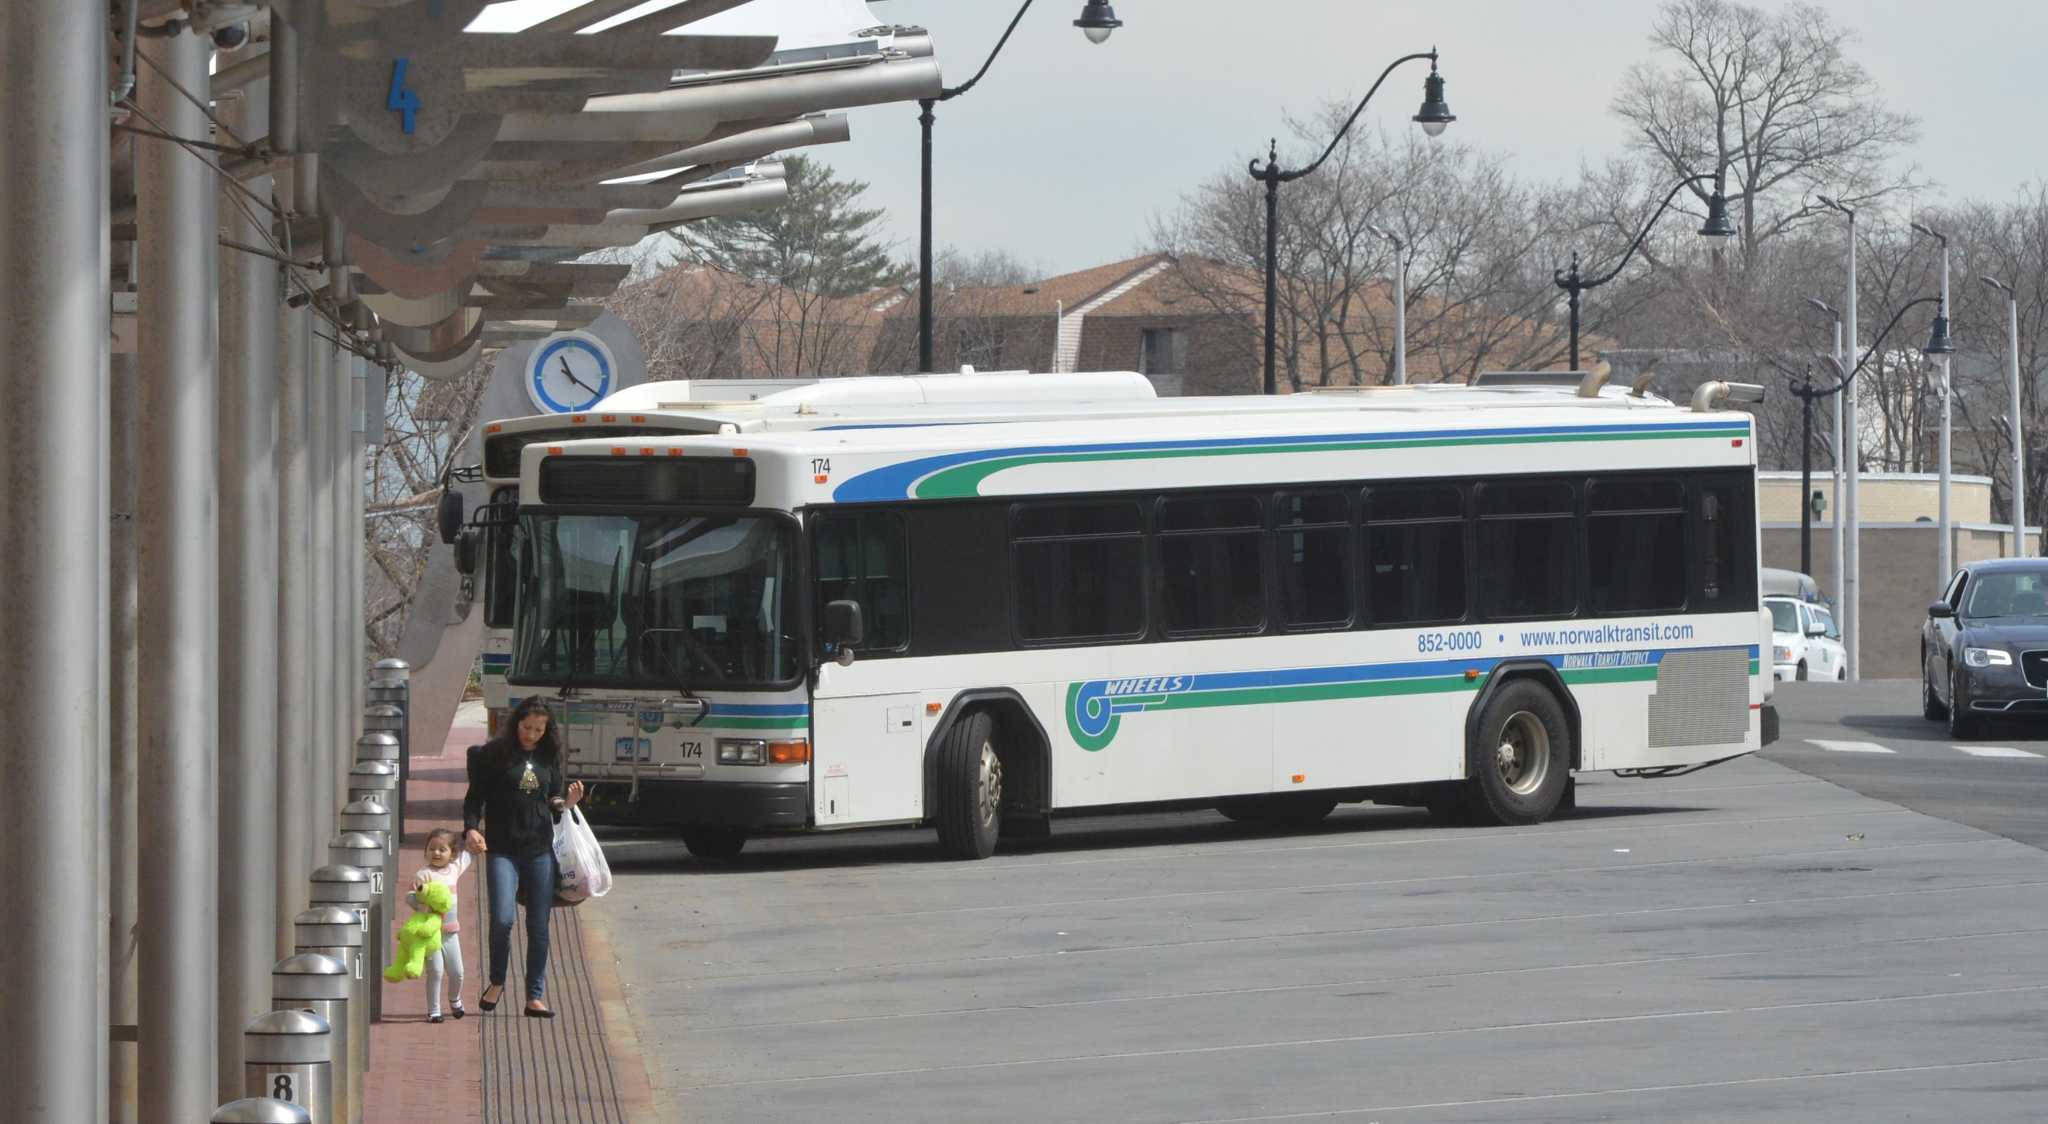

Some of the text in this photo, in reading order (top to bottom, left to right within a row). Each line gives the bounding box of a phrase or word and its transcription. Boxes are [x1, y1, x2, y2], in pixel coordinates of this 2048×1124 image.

[387, 57, 424, 134] 4
[810, 458, 831, 474] 174
[1418, 623, 1693, 652] 852-0000 www.norwalktransit.com
[1104, 676, 1183, 695] WHEELS
[680, 742, 702, 758] 174
[273, 1074, 293, 1102] 8
